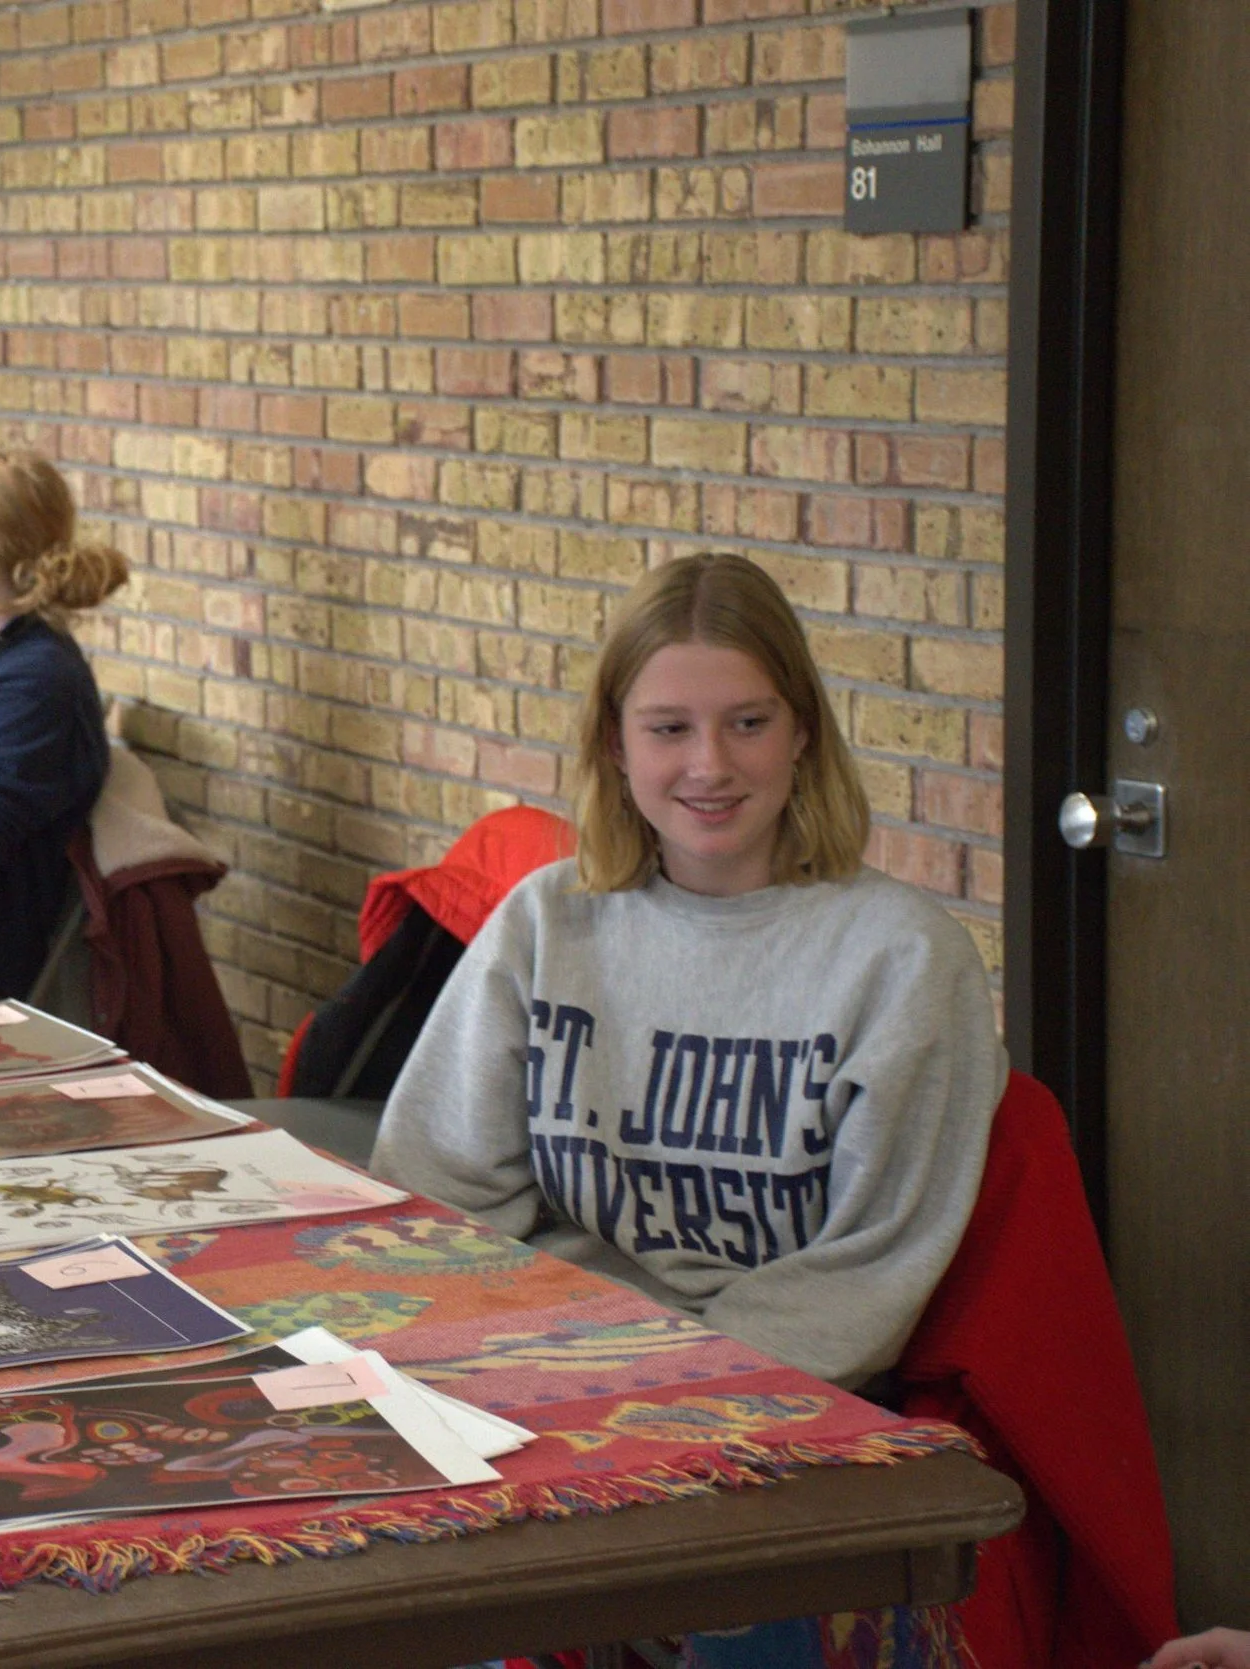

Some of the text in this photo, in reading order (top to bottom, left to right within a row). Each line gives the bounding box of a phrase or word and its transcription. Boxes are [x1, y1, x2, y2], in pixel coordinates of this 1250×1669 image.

[851, 166, 877, 200] 81
[916, 133, 942, 153] Hall
[619, 1031, 836, 1158] JOHN'S
[529, 1133, 830, 1269] NIVERSIT
